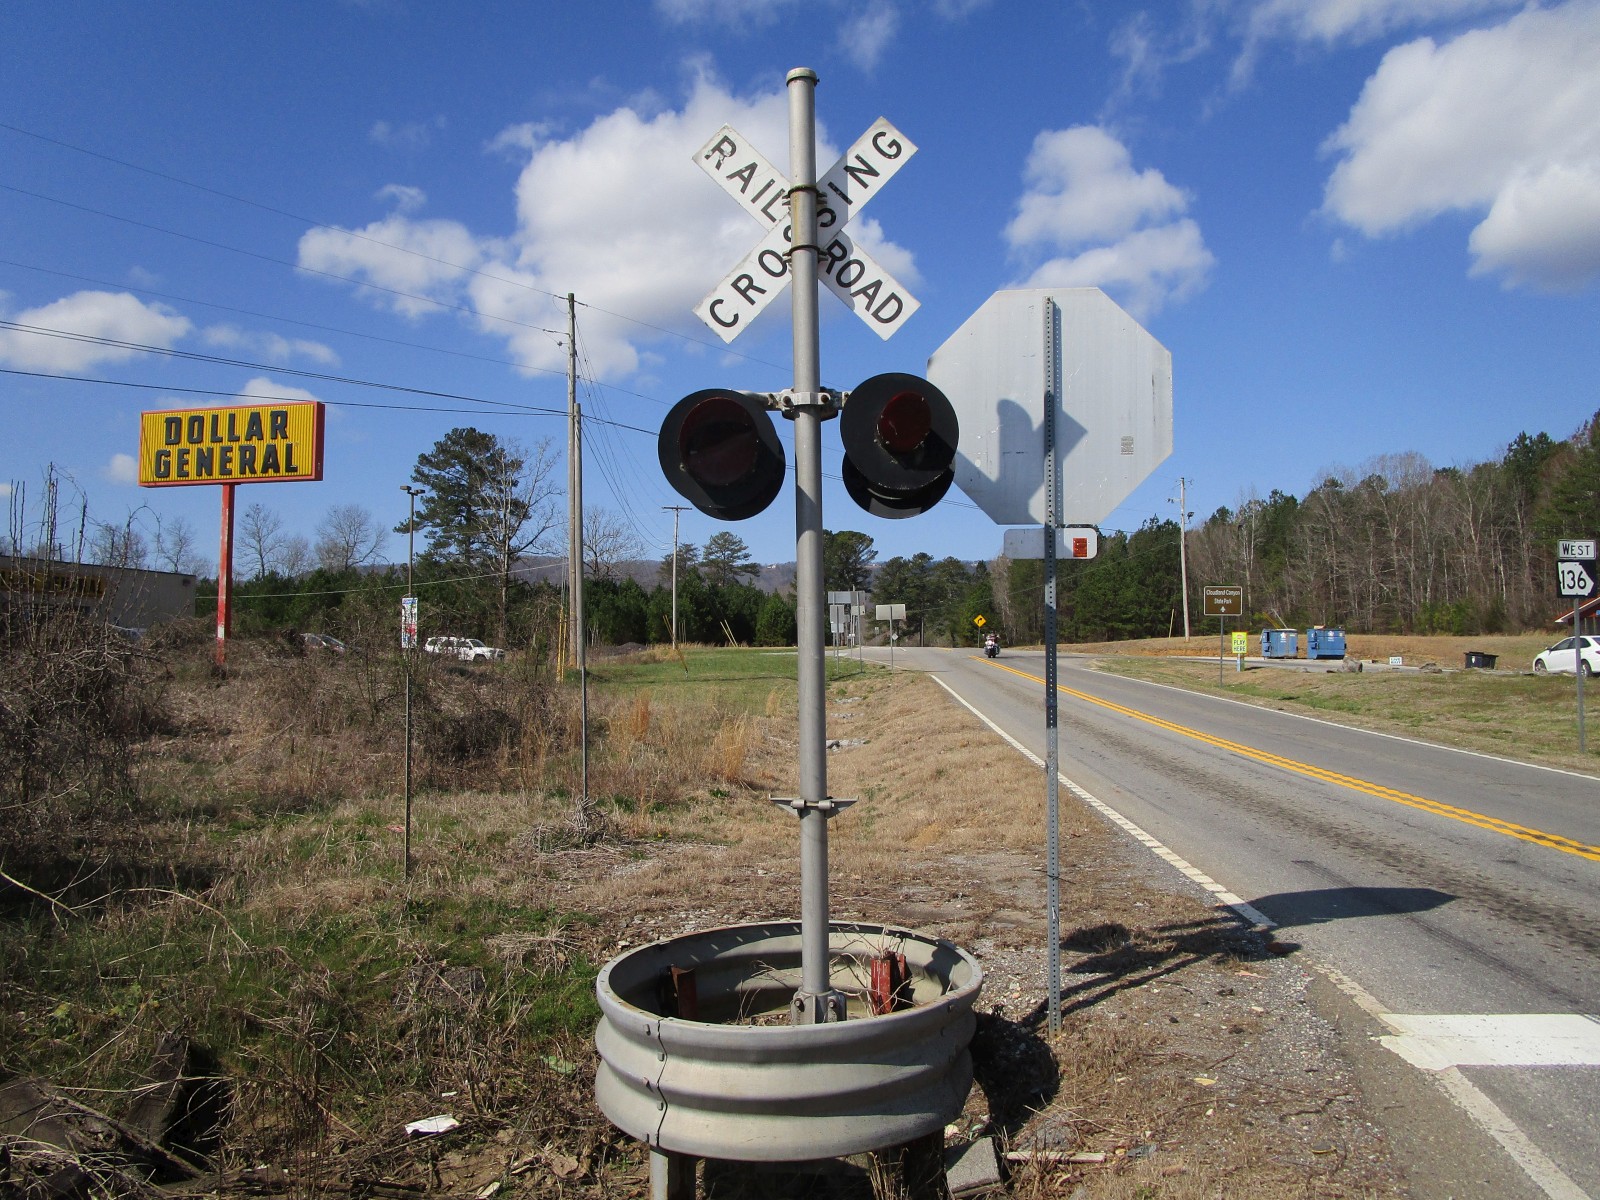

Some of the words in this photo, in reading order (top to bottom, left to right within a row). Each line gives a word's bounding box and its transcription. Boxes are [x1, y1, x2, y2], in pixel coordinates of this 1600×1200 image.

[164, 409, 288, 446] DOLLAR
[154, 442, 299, 479] GENERAL
[1562, 543, 1590, 555] WEST
[1561, 570, 1587, 590] 136
